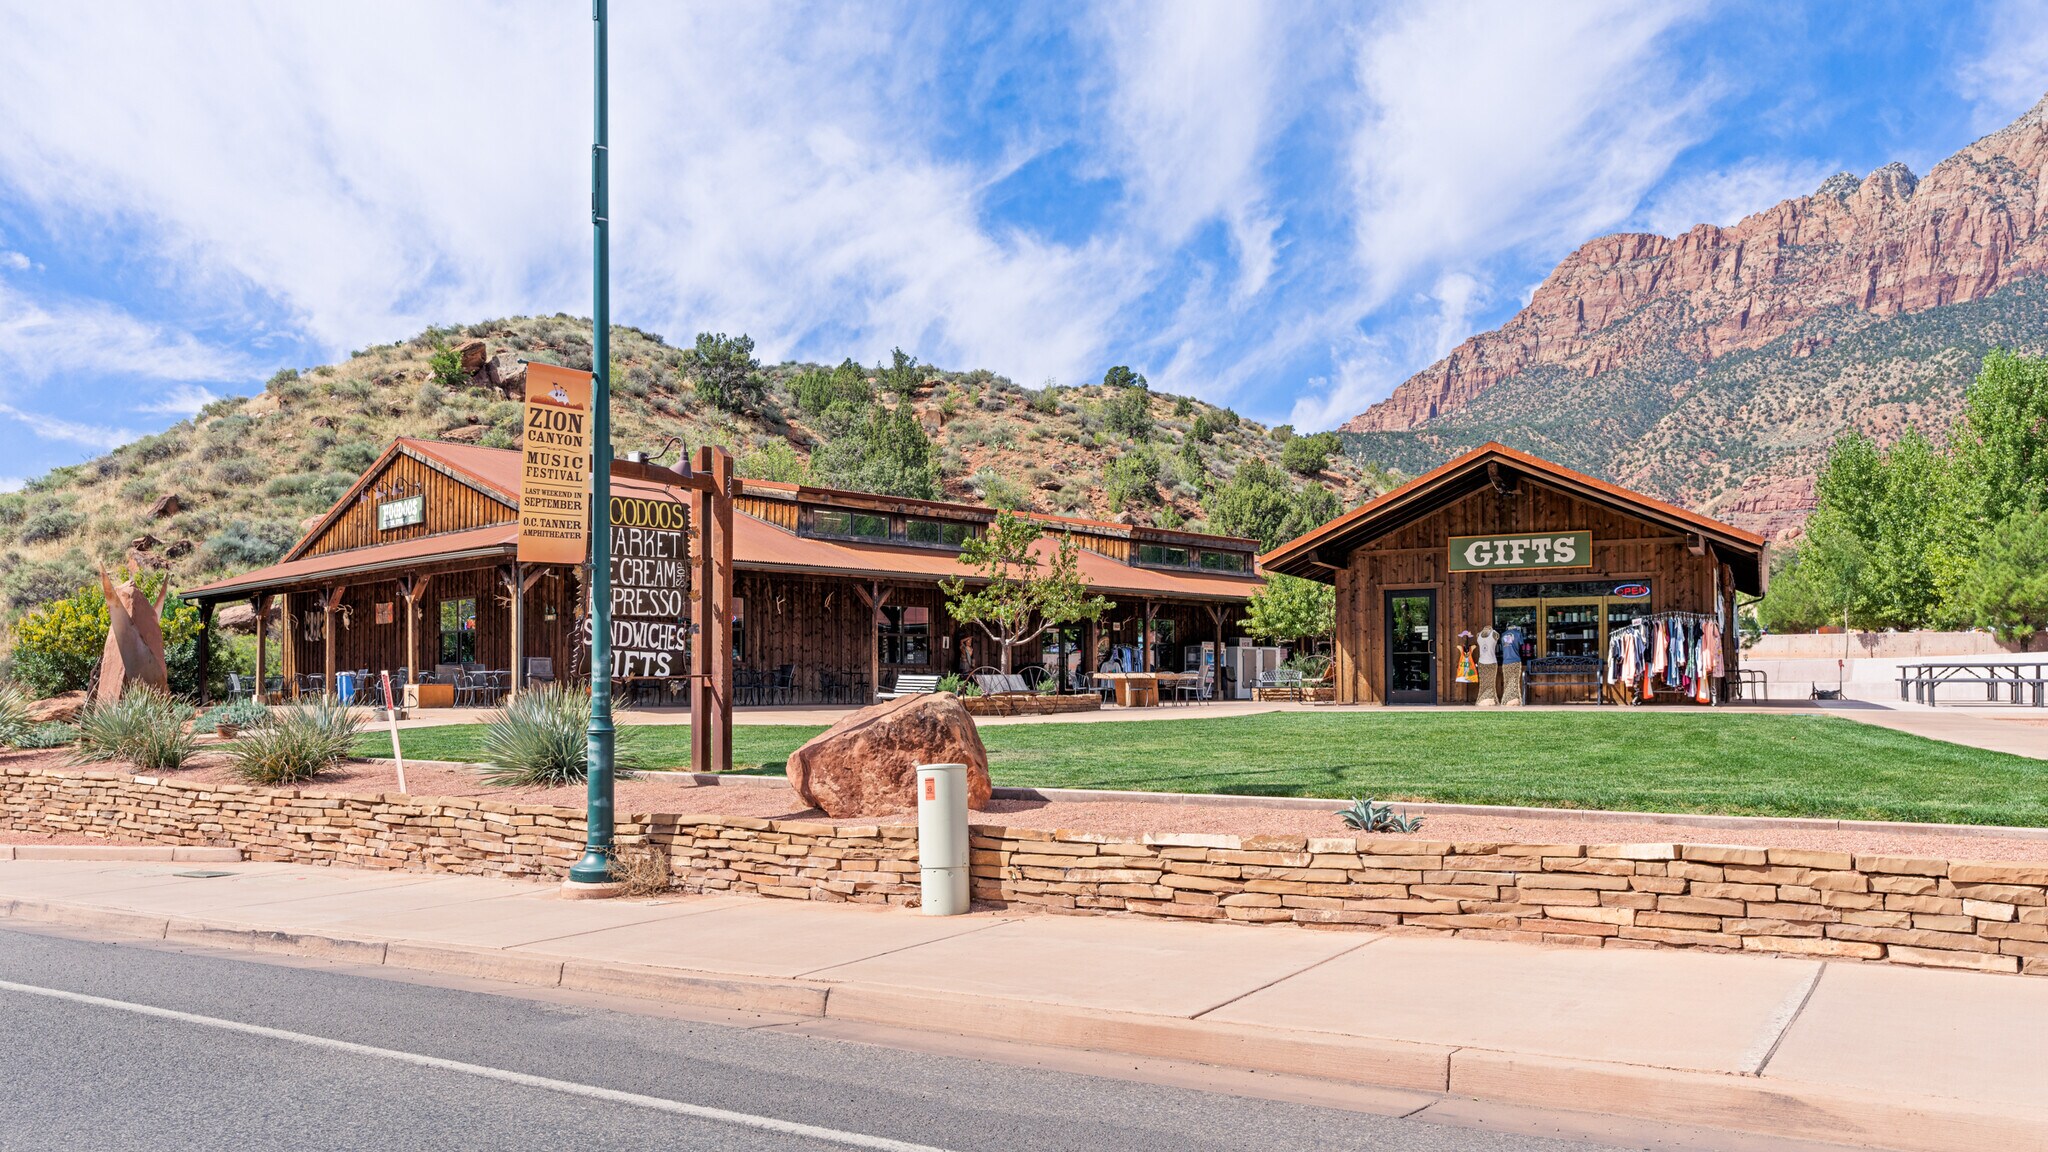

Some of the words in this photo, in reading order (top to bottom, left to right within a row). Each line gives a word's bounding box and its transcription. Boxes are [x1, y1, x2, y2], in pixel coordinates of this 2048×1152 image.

[528, 407, 584, 434] ZION
[528, 429, 583, 448] CANYON
[527, 451, 583, 470] MUSIC
[526, 466, 583, 482] FESTIVAL
[524, 496, 582, 511] SEPTEMBER
[525, 487, 540, 495] LAST
[541, 489, 573, 498] WEEKEND
[523, 517, 539, 527] O.C.
[540, 518, 582, 530] TANNER
[610, 497, 684, 529] OODOOS
[523, 529, 582, 540] AMPHITHEATER
[610, 527, 681, 558] ARKET
[1463, 536, 1576, 567] GIFTS
[620, 557, 676, 588] CREAM
[588, 587, 681, 616] PRESSO
[1616, 586, 1647, 597] OPEN
[583, 620, 685, 651] SNDWICHES
[610, 650, 672, 677] IFTS
